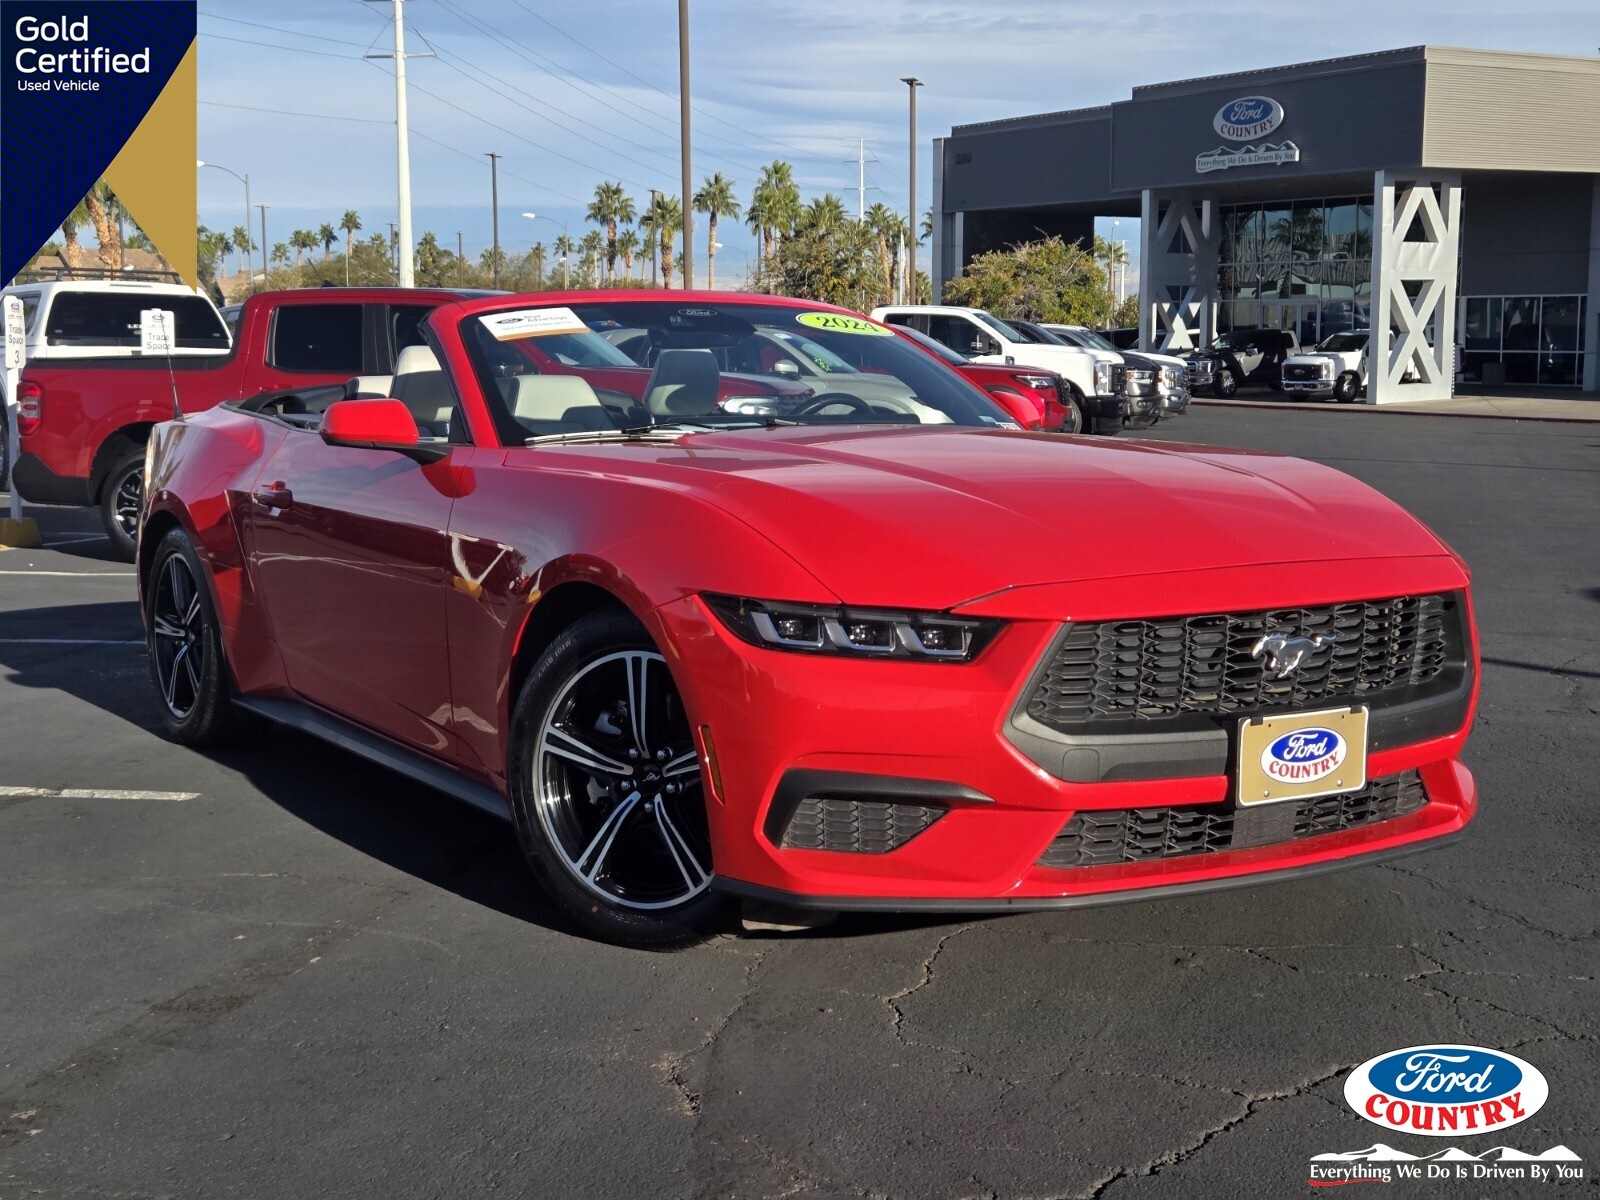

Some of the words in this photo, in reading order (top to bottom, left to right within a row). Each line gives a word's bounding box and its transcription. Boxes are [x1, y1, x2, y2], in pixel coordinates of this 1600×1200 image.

[1230, 101, 1264, 121] Ford
[1220, 117, 1274, 138] COUNTRY
[1197, 157, 1227, 168] Everything
[1227, 156, 1237, 165] We
[1238, 155, 1248, 164] Do
[1254, 153, 1274, 163] Driven
[1274, 152, 1283, 163] By
[1284, 151, 1296, 160] You
[816, 316, 879, 333] 2024
[147, 332, 170, 341] Trade
[146, 341, 171, 350] Space
[14, 350, 20, 364] 3
[1283, 733, 1328, 760] Ford
[1269, 751, 1338, 778] COUNTRY
